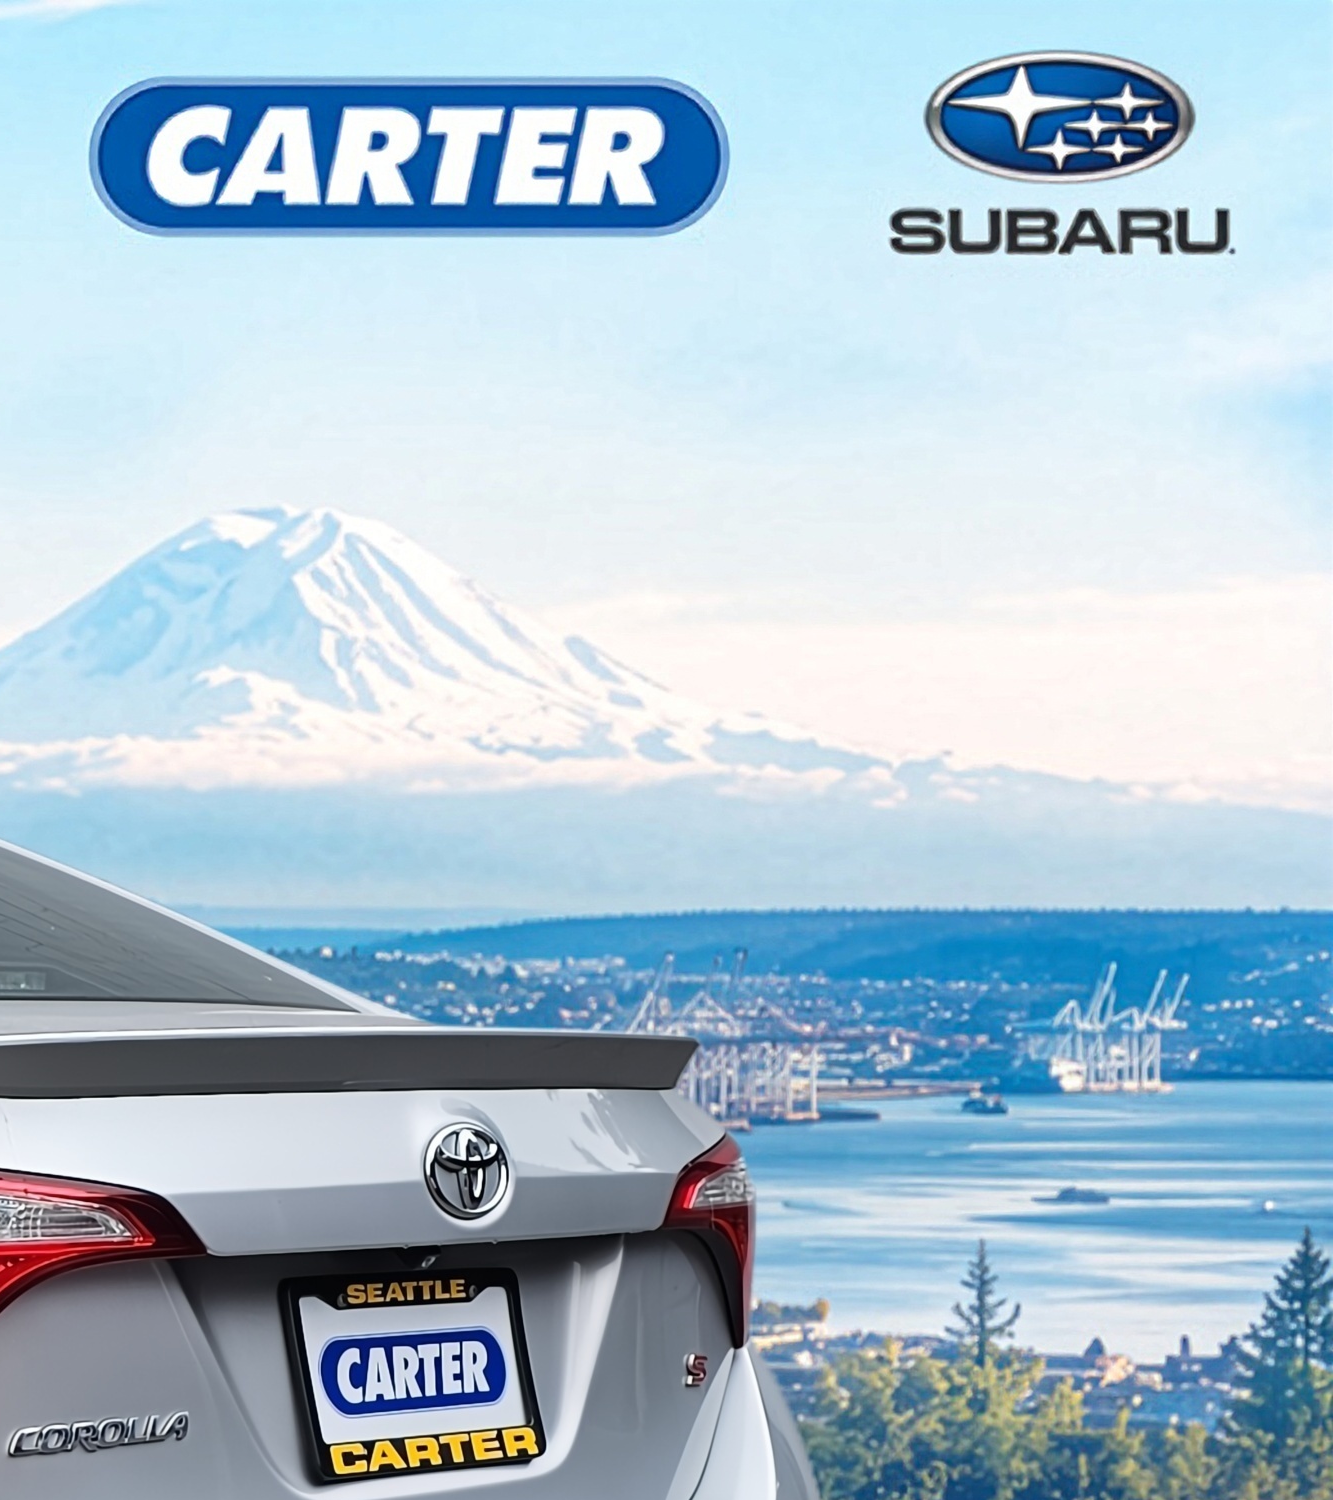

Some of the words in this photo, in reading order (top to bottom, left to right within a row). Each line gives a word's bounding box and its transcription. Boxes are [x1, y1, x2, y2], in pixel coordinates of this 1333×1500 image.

[346, 1279, 467, 1304] SEATTLE
[337, 1340, 490, 1404] CARTER
[685, 1353, 708, 1387] S
[7, 1411, 190, 1457] COROLLA
[329, 1426, 539, 1475] CARTER
